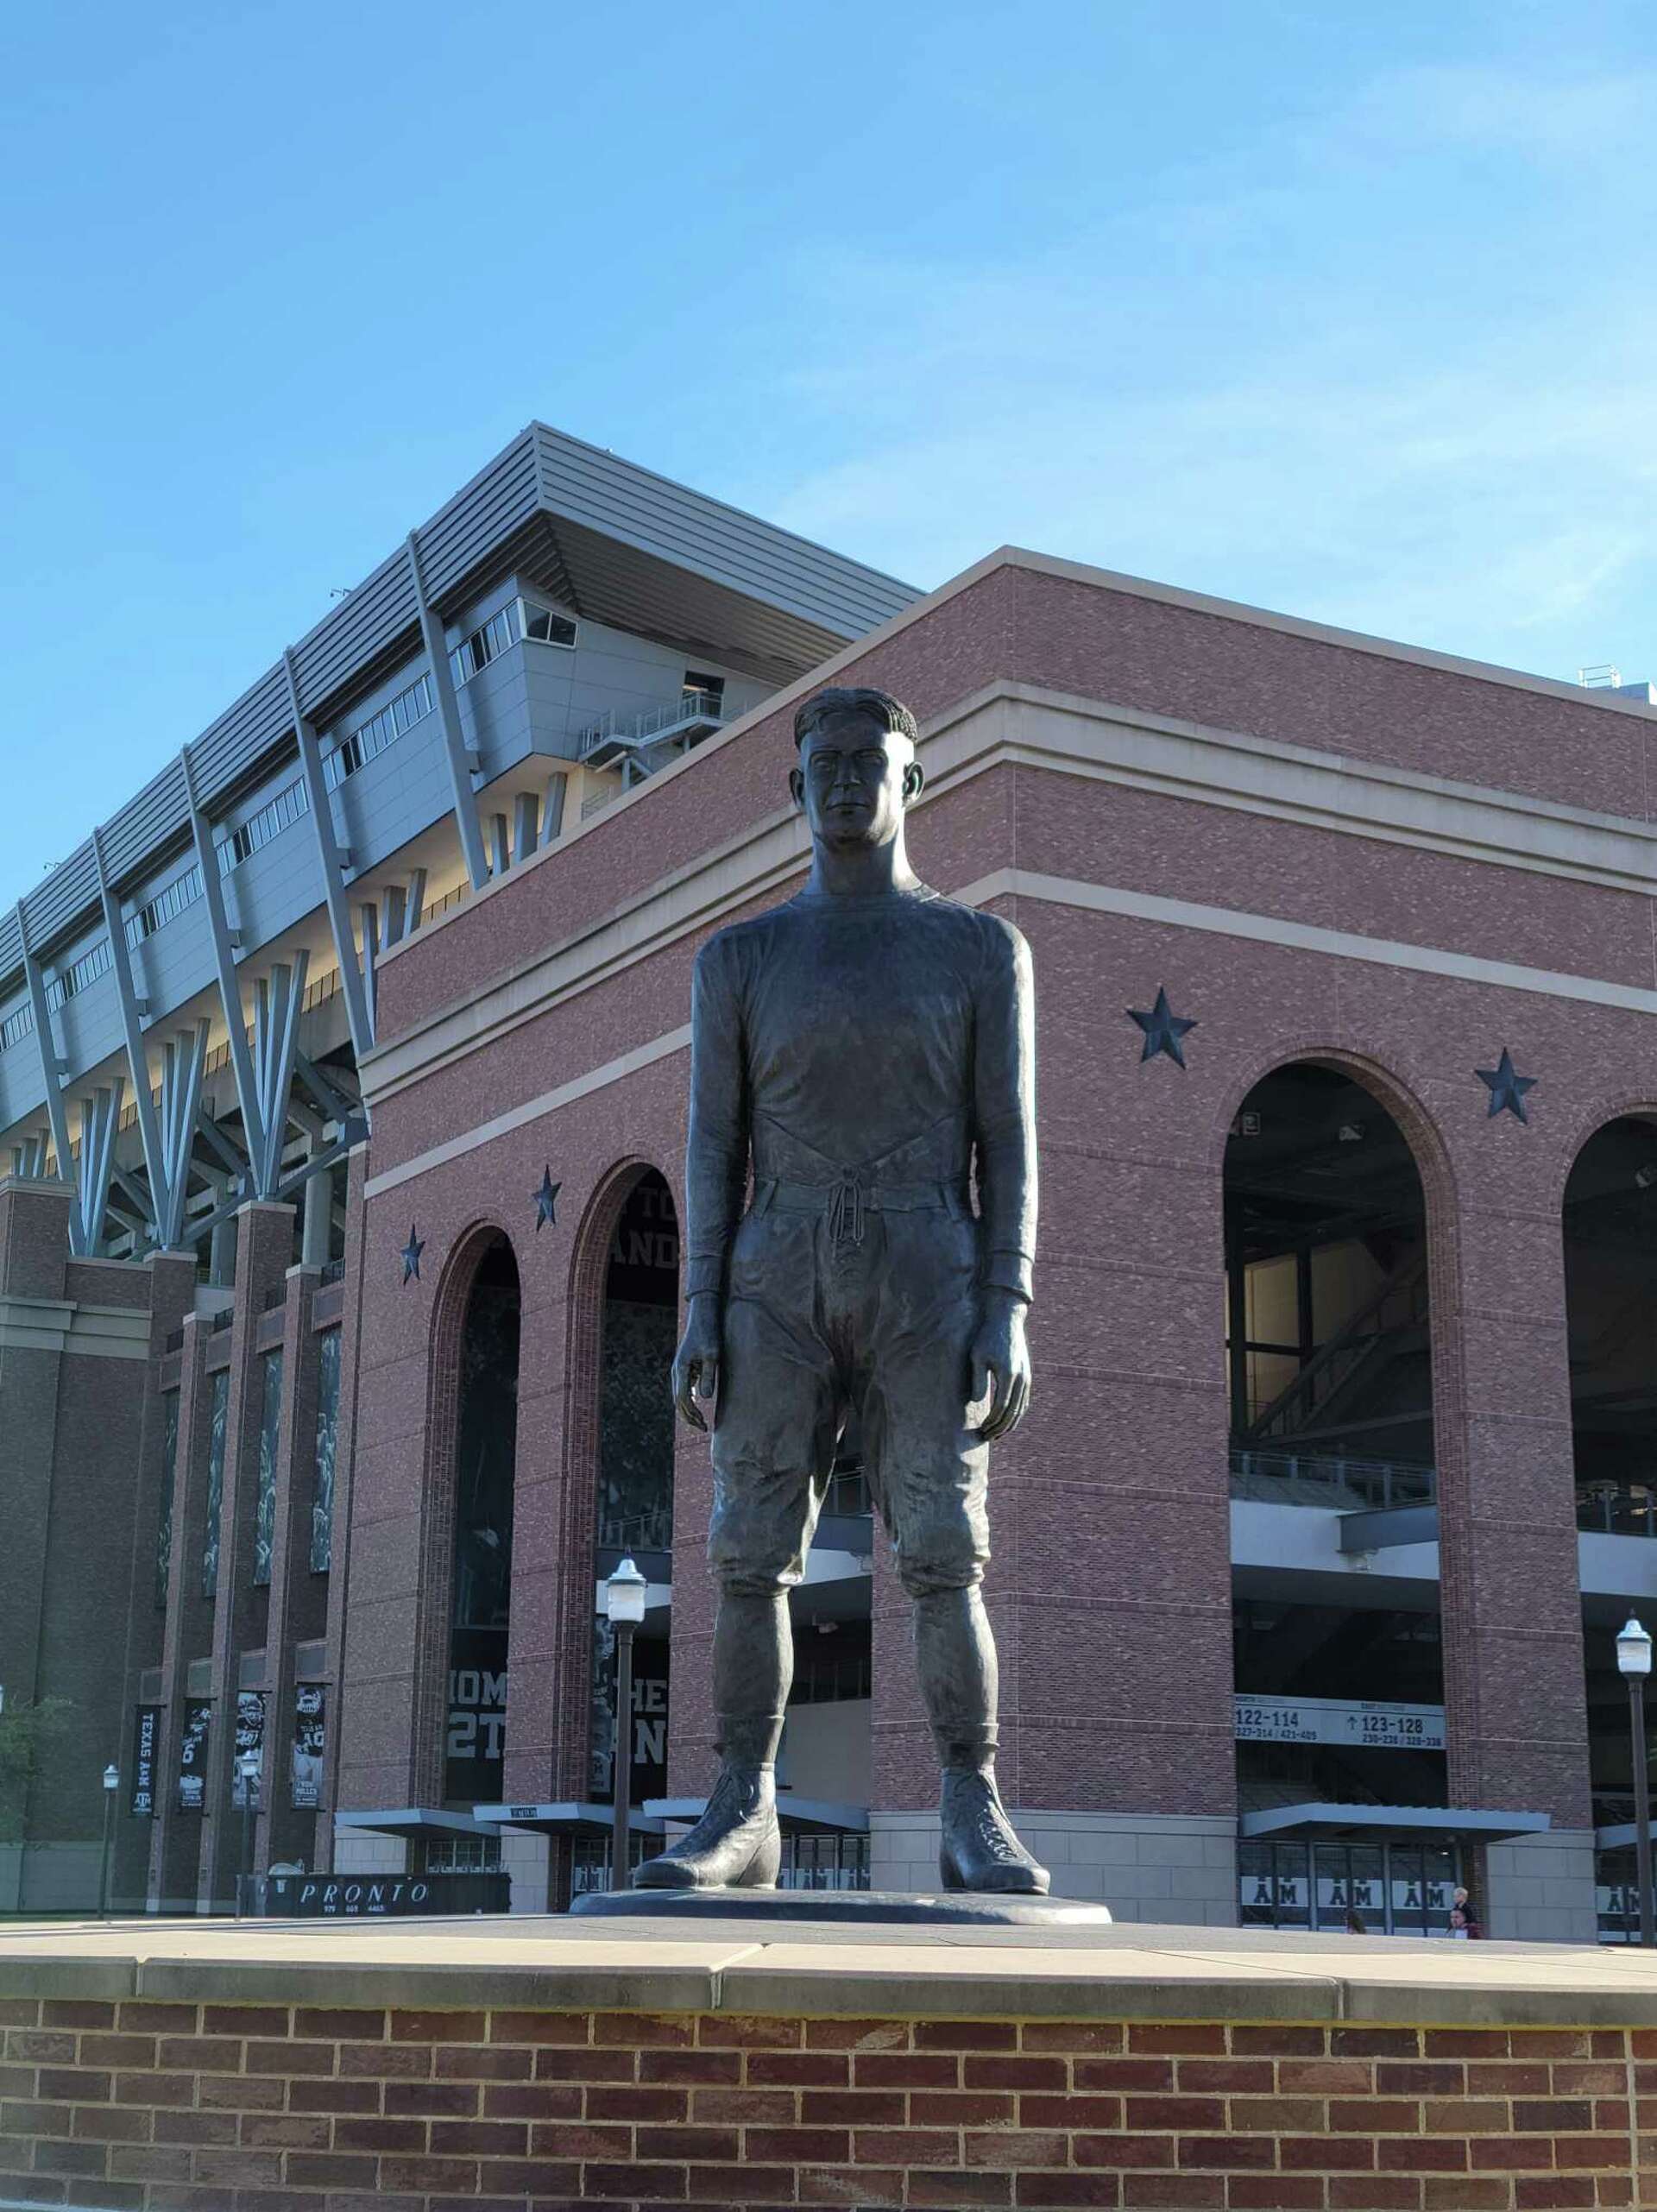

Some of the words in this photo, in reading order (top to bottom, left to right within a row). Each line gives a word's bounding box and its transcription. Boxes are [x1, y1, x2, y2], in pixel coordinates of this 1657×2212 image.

[1237, 1709, 1299, 1727] 122-114
[1362, 1716, 1423, 1735] 123-128
[141, 1713, 154, 1758] TEXAS
[301, 1884, 428, 1902] PRONTO
